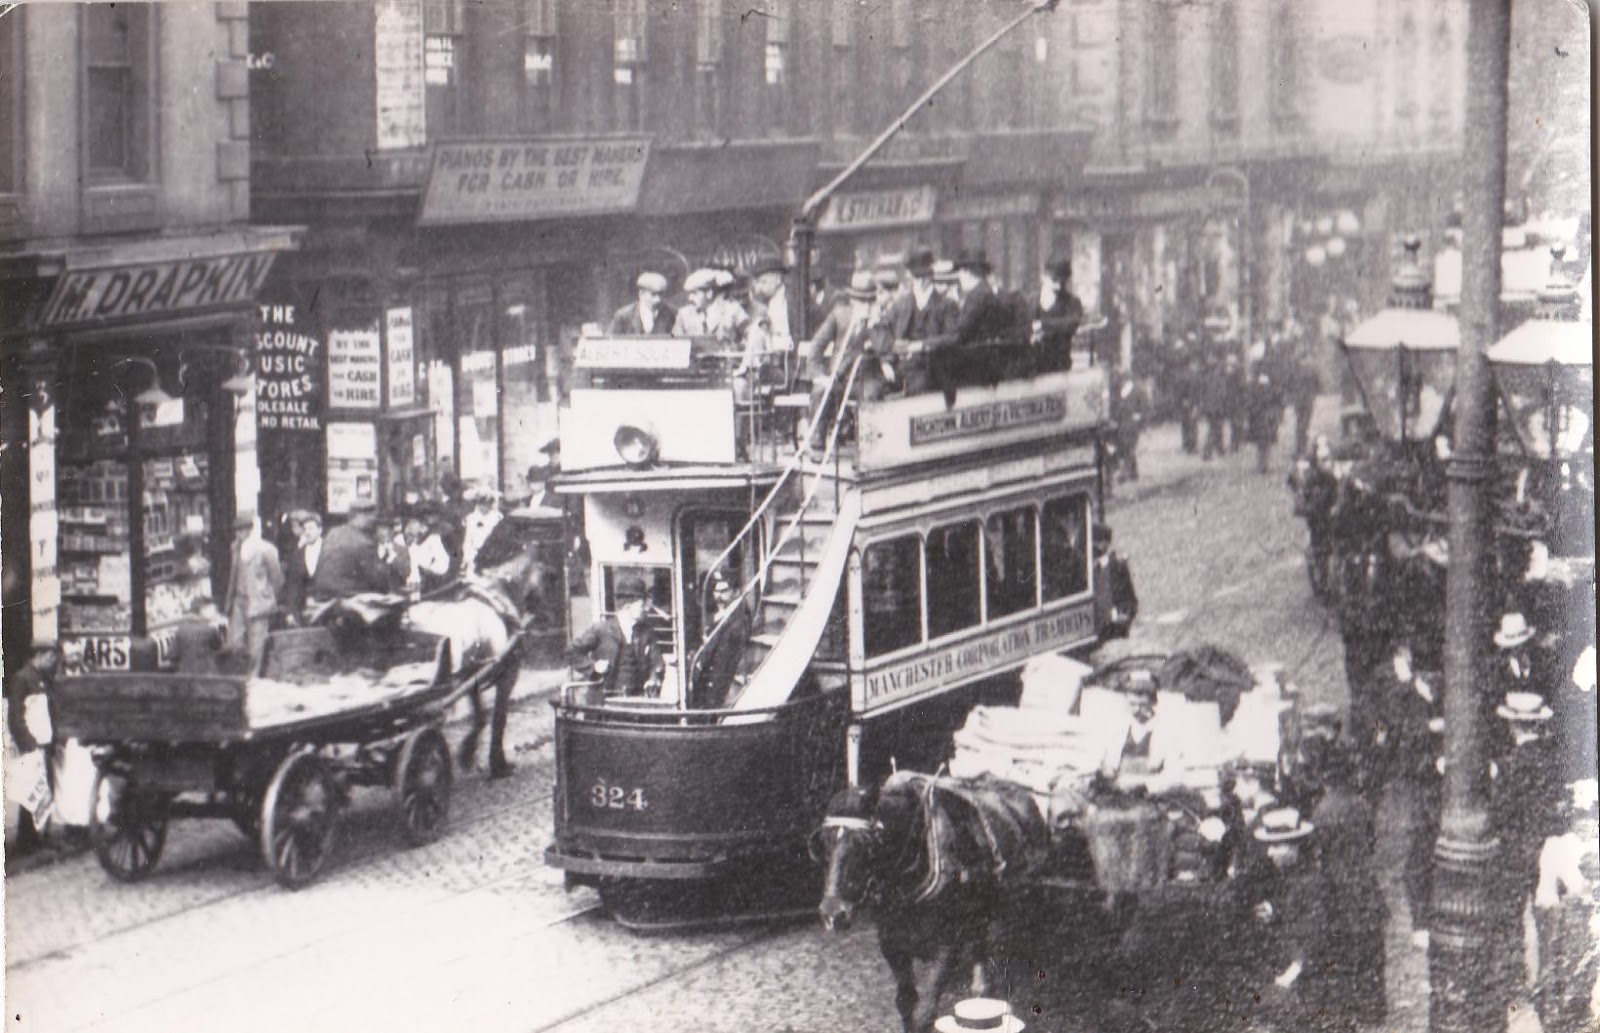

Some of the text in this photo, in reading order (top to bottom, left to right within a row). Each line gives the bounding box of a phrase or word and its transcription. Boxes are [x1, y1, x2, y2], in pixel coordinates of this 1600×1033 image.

[499, 149, 522, 167] BY
[457, 173, 491, 193] FOR
[501, 172, 547, 190] CASH
[557, 171, 579, 188] OR
[96, 255, 270, 317] DRAPKIN
[260, 304, 295, 323] THE
[261, 355, 304, 373] USIC
[347, 370, 377, 382] CASH
[257, 375, 312, 398] TORES
[258, 401, 308, 414] OLESALE
[282, 416, 320, 429] RETAIL
[868, 658, 952, 699] MANCHESTER
[956, 629, 1031, 670] CORPORATION
[592, 784, 648, 811] 324
